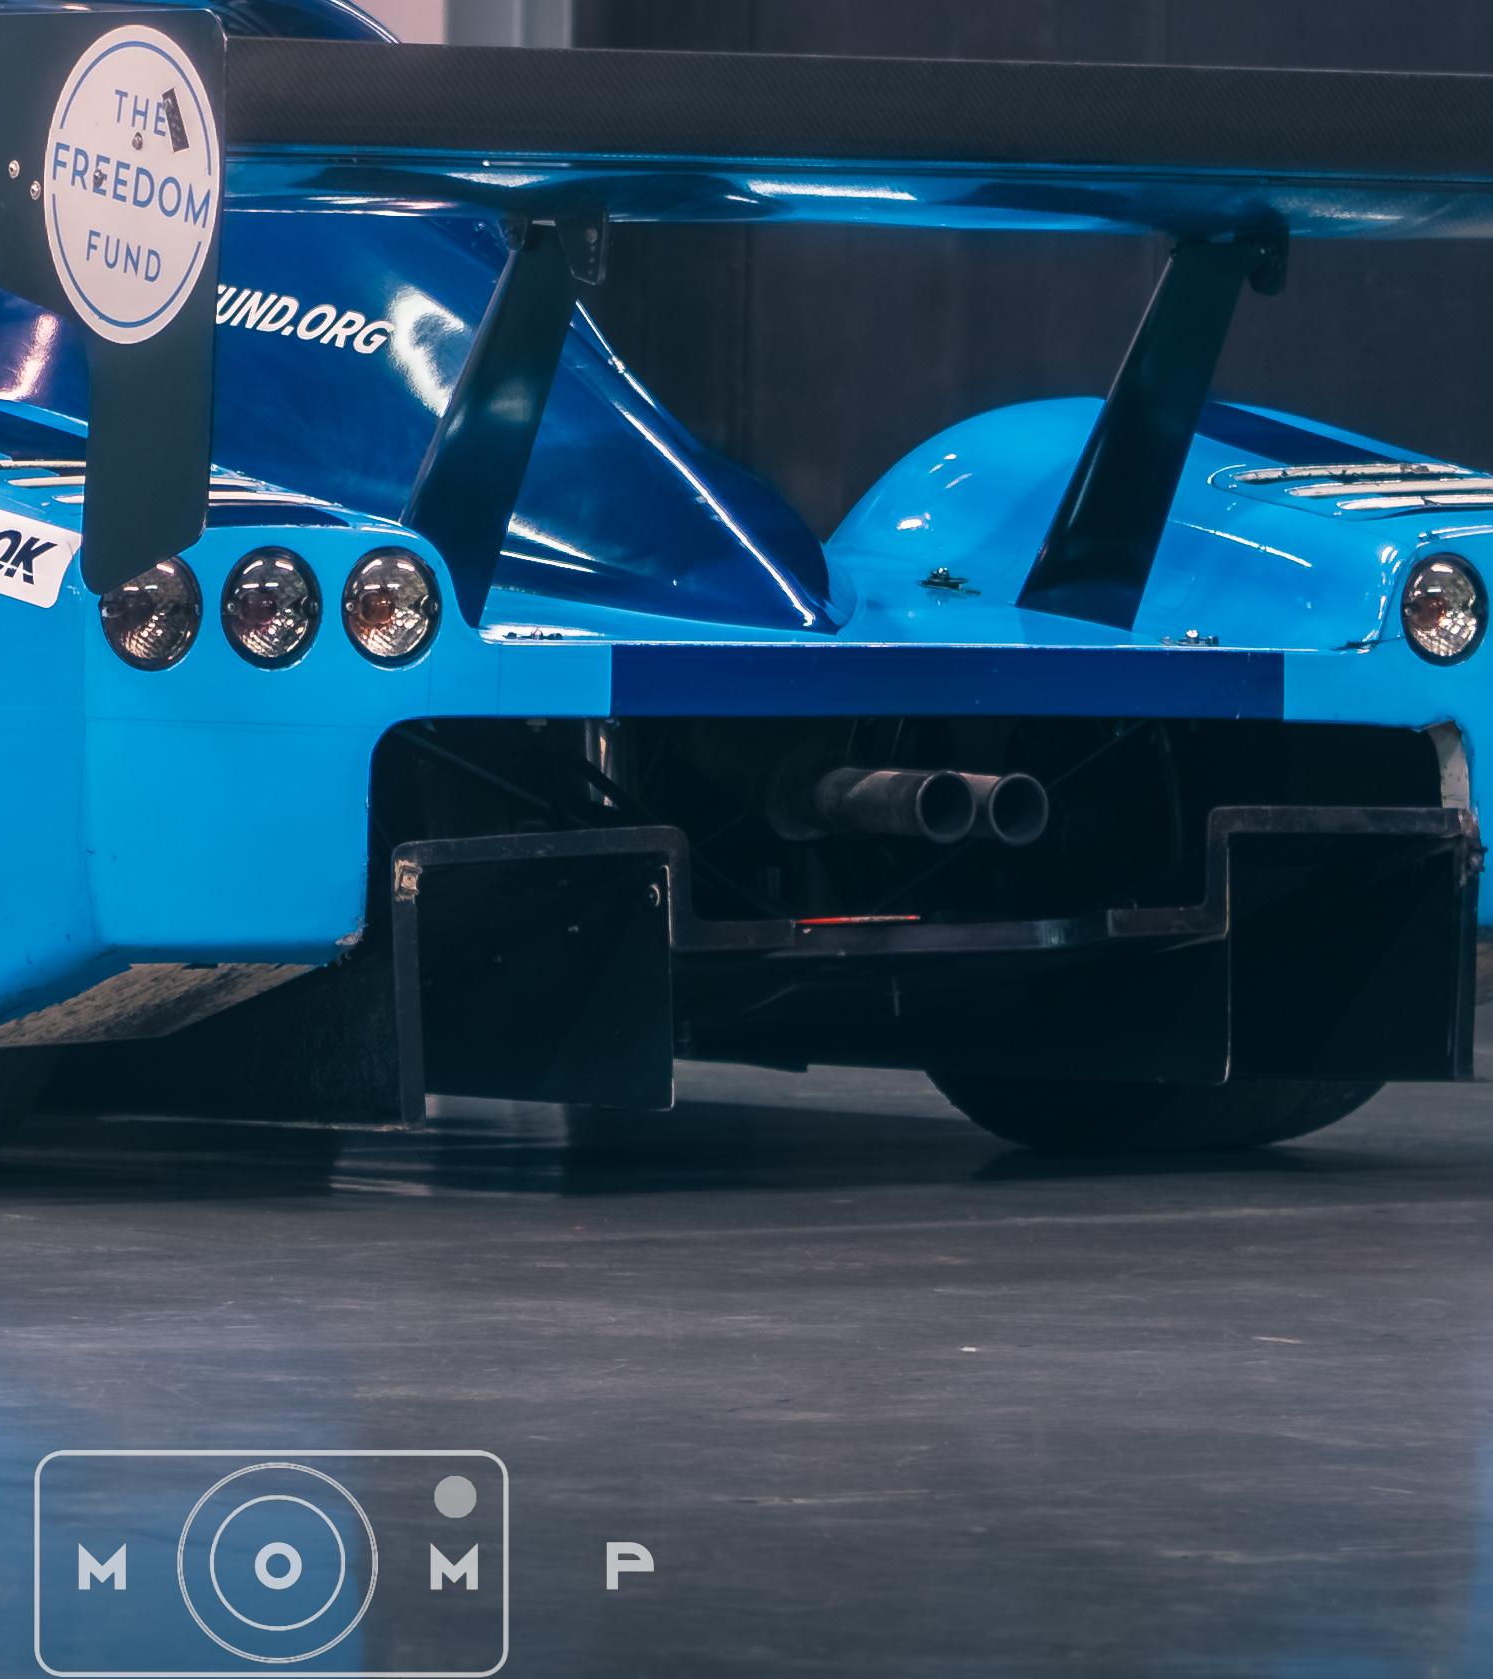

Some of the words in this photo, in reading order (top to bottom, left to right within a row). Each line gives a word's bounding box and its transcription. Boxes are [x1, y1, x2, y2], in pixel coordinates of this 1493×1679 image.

[114, 88, 168, 137] THE
[52, 141, 212, 230] FREEDOM
[85, 229, 162, 283] FUND
[215, 283, 394, 355] UND.ORG
